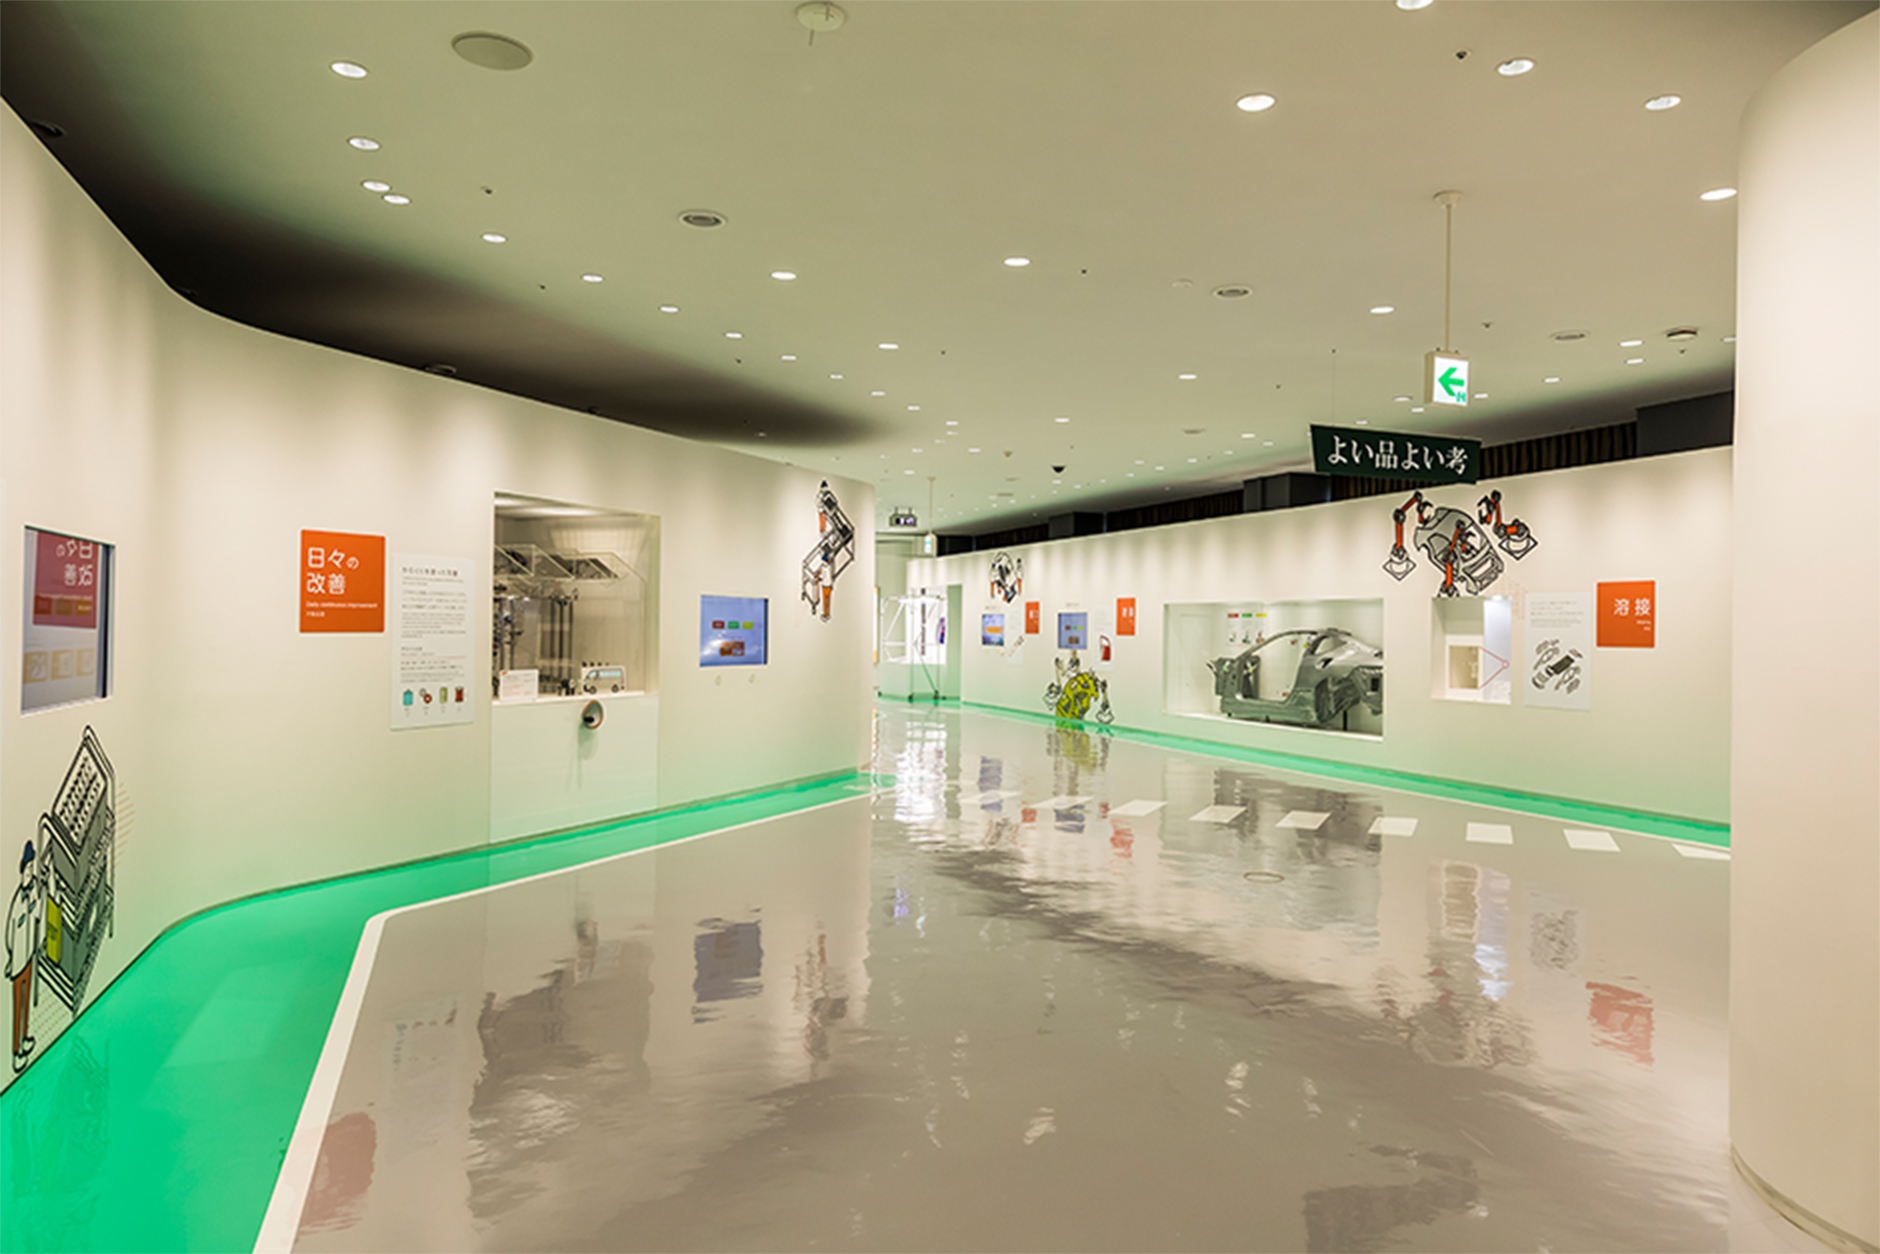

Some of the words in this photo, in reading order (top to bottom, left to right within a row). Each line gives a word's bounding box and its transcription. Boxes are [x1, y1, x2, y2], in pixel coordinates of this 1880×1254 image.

[1328, 435, 1468, 475] よい品よい考
[308, 547, 360, 570] 日々の
[306, 573, 347, 595] 改善
[1613, 597, 1652, 616] 溶接
